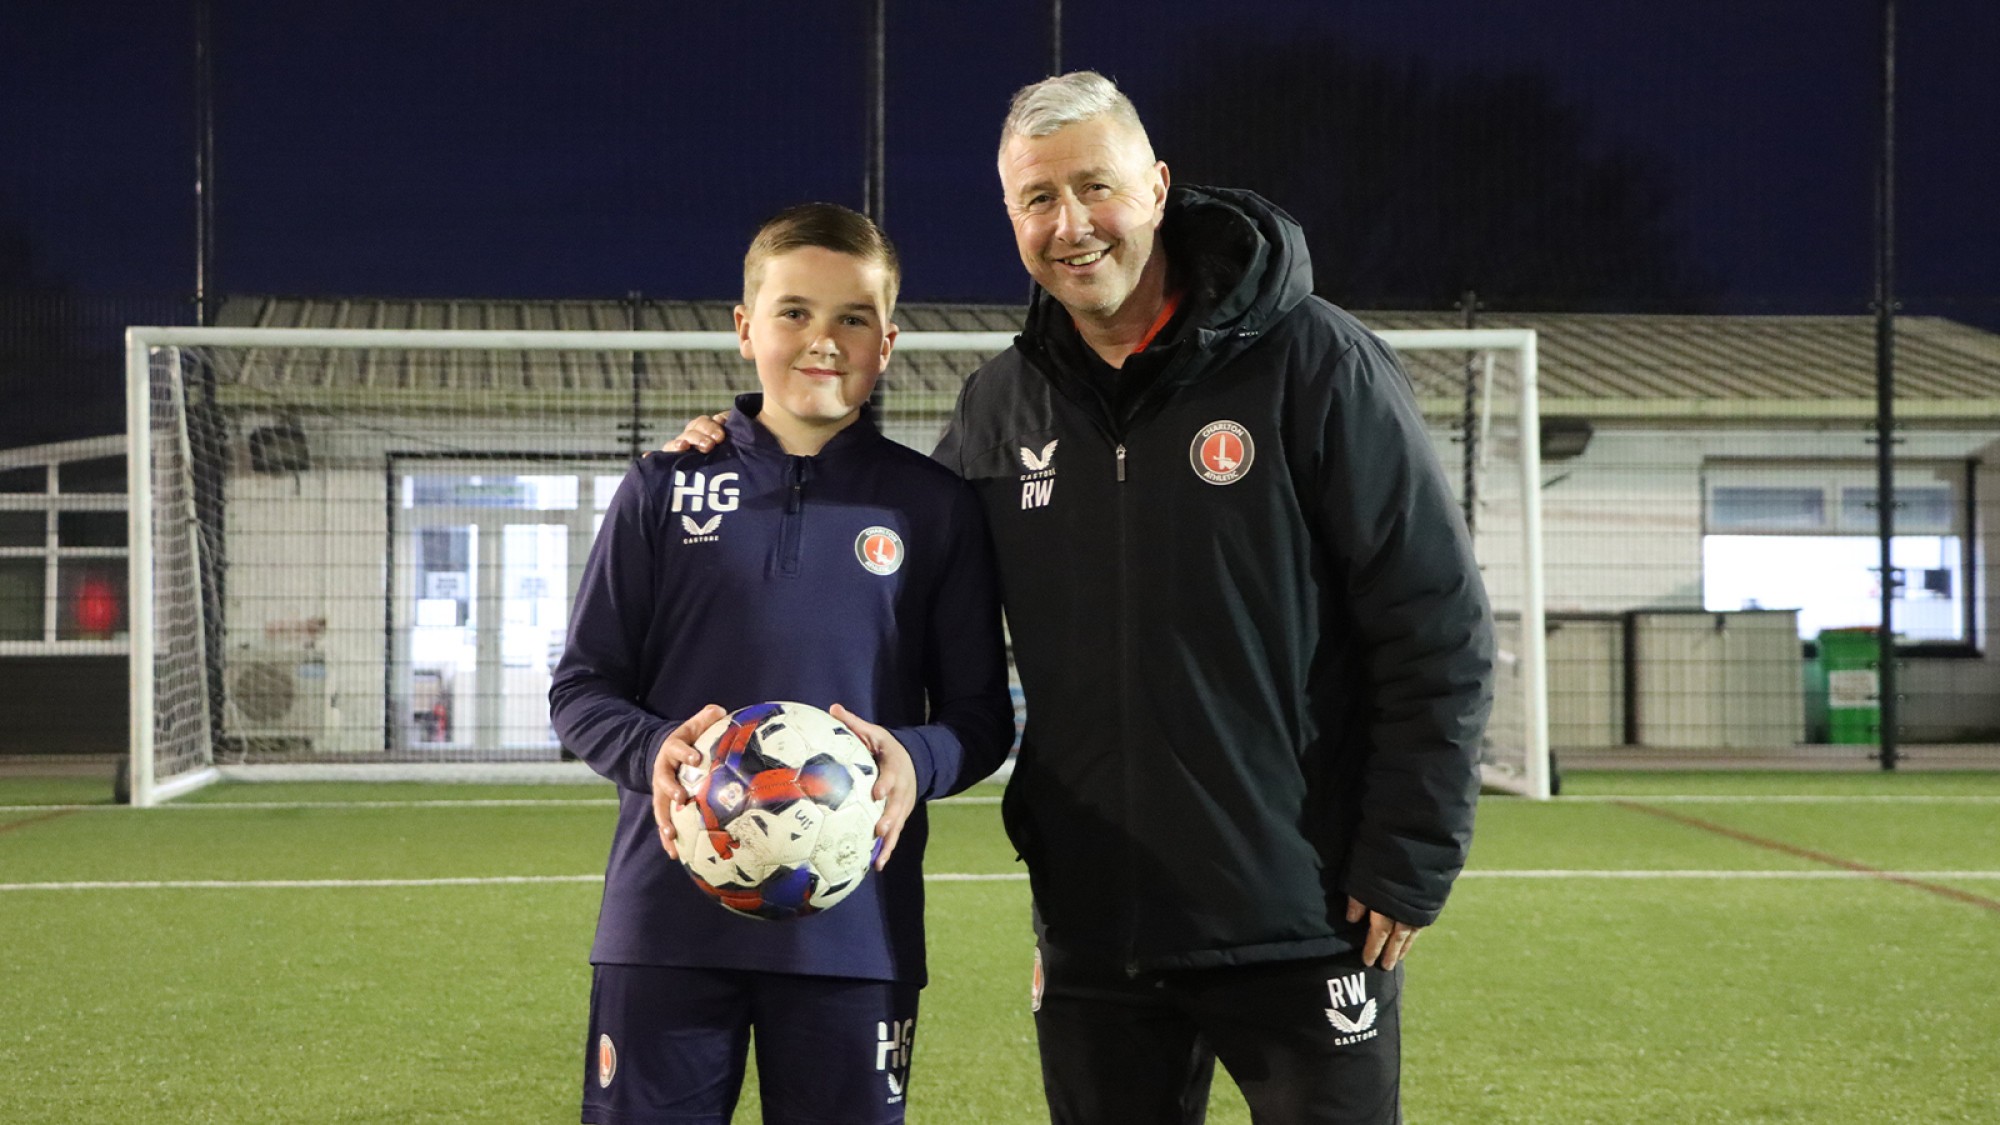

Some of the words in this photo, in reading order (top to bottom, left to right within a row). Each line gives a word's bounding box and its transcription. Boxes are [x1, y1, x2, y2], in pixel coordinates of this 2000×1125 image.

[1202, 424, 1244, 437] CHARLTON
[671, 470, 740, 512] HG
[1021, 478, 1054, 510] RW
[1327, 971, 1366, 1010] RW
[1334, 1028, 1378, 1046] CASTORE
